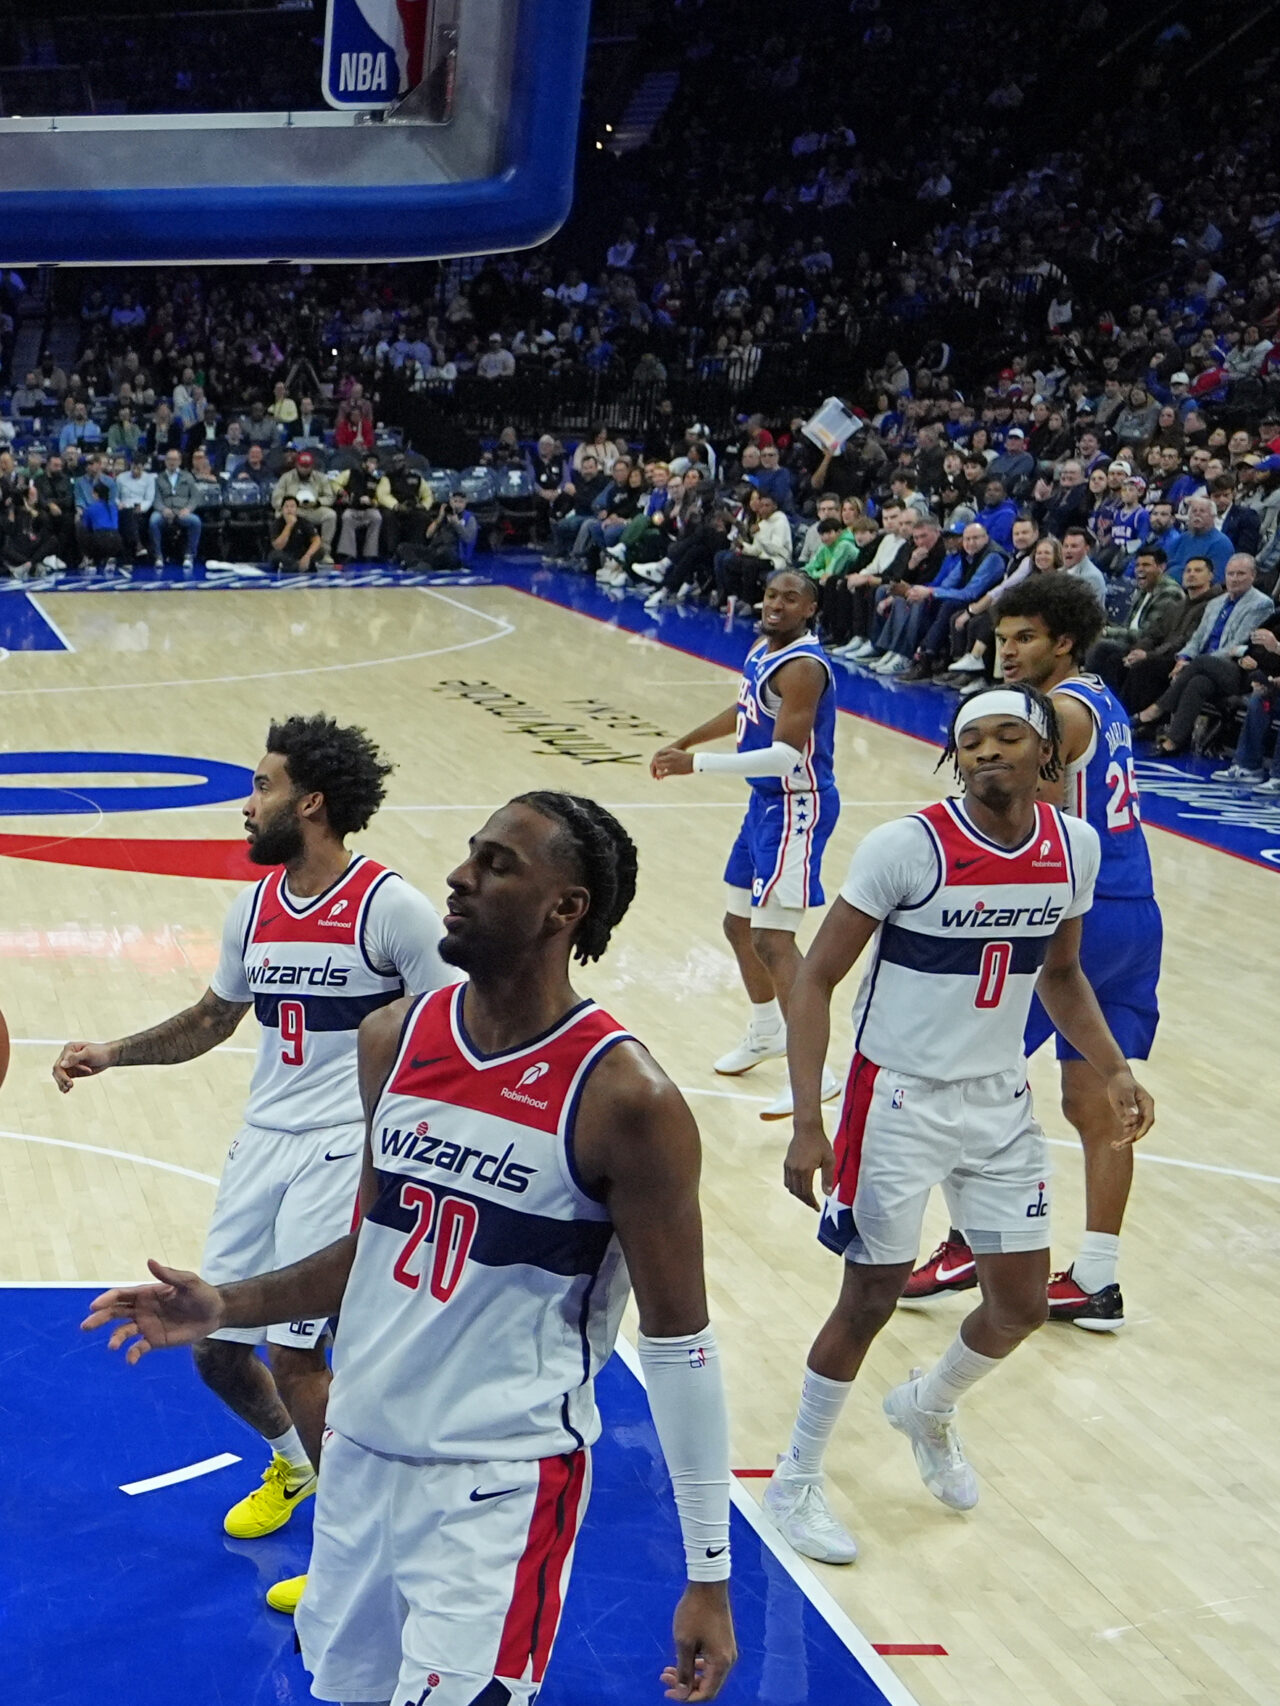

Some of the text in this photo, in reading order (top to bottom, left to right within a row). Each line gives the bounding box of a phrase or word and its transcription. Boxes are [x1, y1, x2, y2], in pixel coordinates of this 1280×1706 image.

[338, 51, 387, 92] NBA
[317, 918, 352, 929] Robinhood
[941, 895, 1065, 928] wizards
[246, 955, 352, 987] wizards
[974, 940, 1013, 1011] 0
[277, 999, 306, 1068] 9
[500, 1087, 548, 1111] Robinhood
[380, 1120, 539, 1195] wizards
[392, 1180, 479, 1304] 20
